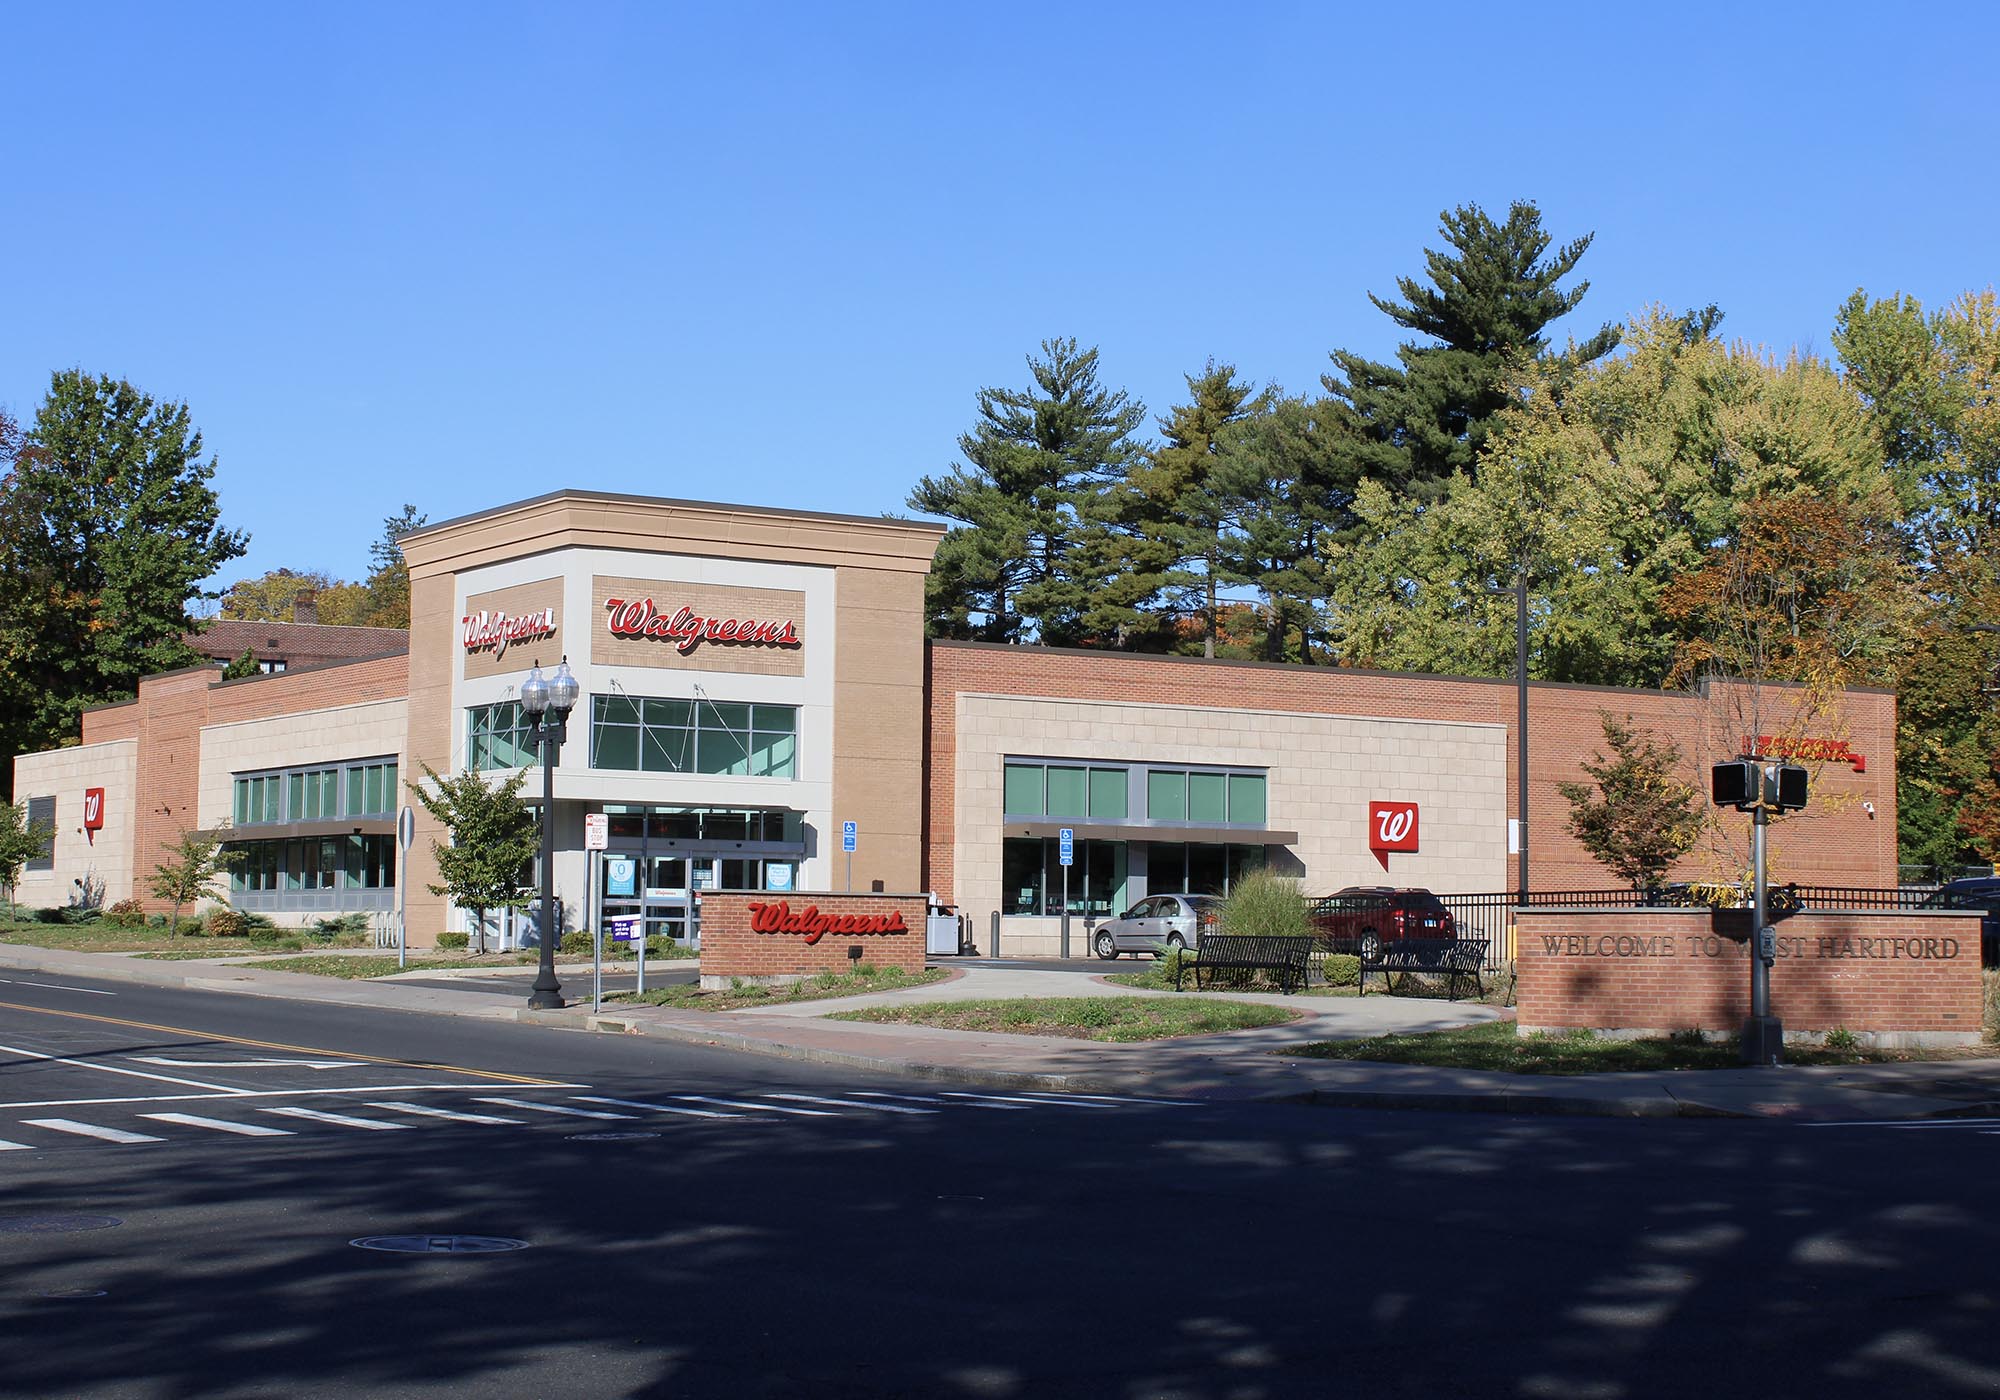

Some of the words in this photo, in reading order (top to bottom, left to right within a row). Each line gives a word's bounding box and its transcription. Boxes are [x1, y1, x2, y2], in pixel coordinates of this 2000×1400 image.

[462, 608, 556, 654] Walgreens
[605, 598, 800, 650] Walgreens
[86, 793, 99, 822] W
[1376, 809, 1414, 842] W
[748, 900, 908, 944] Walgreens
[1540, 935, 1674, 958] WELCOME
[1686, 936, 1722, 958] TO
[1736, 936, 1807, 958] WST
[1816, 936, 1960, 959] HARTFORD
